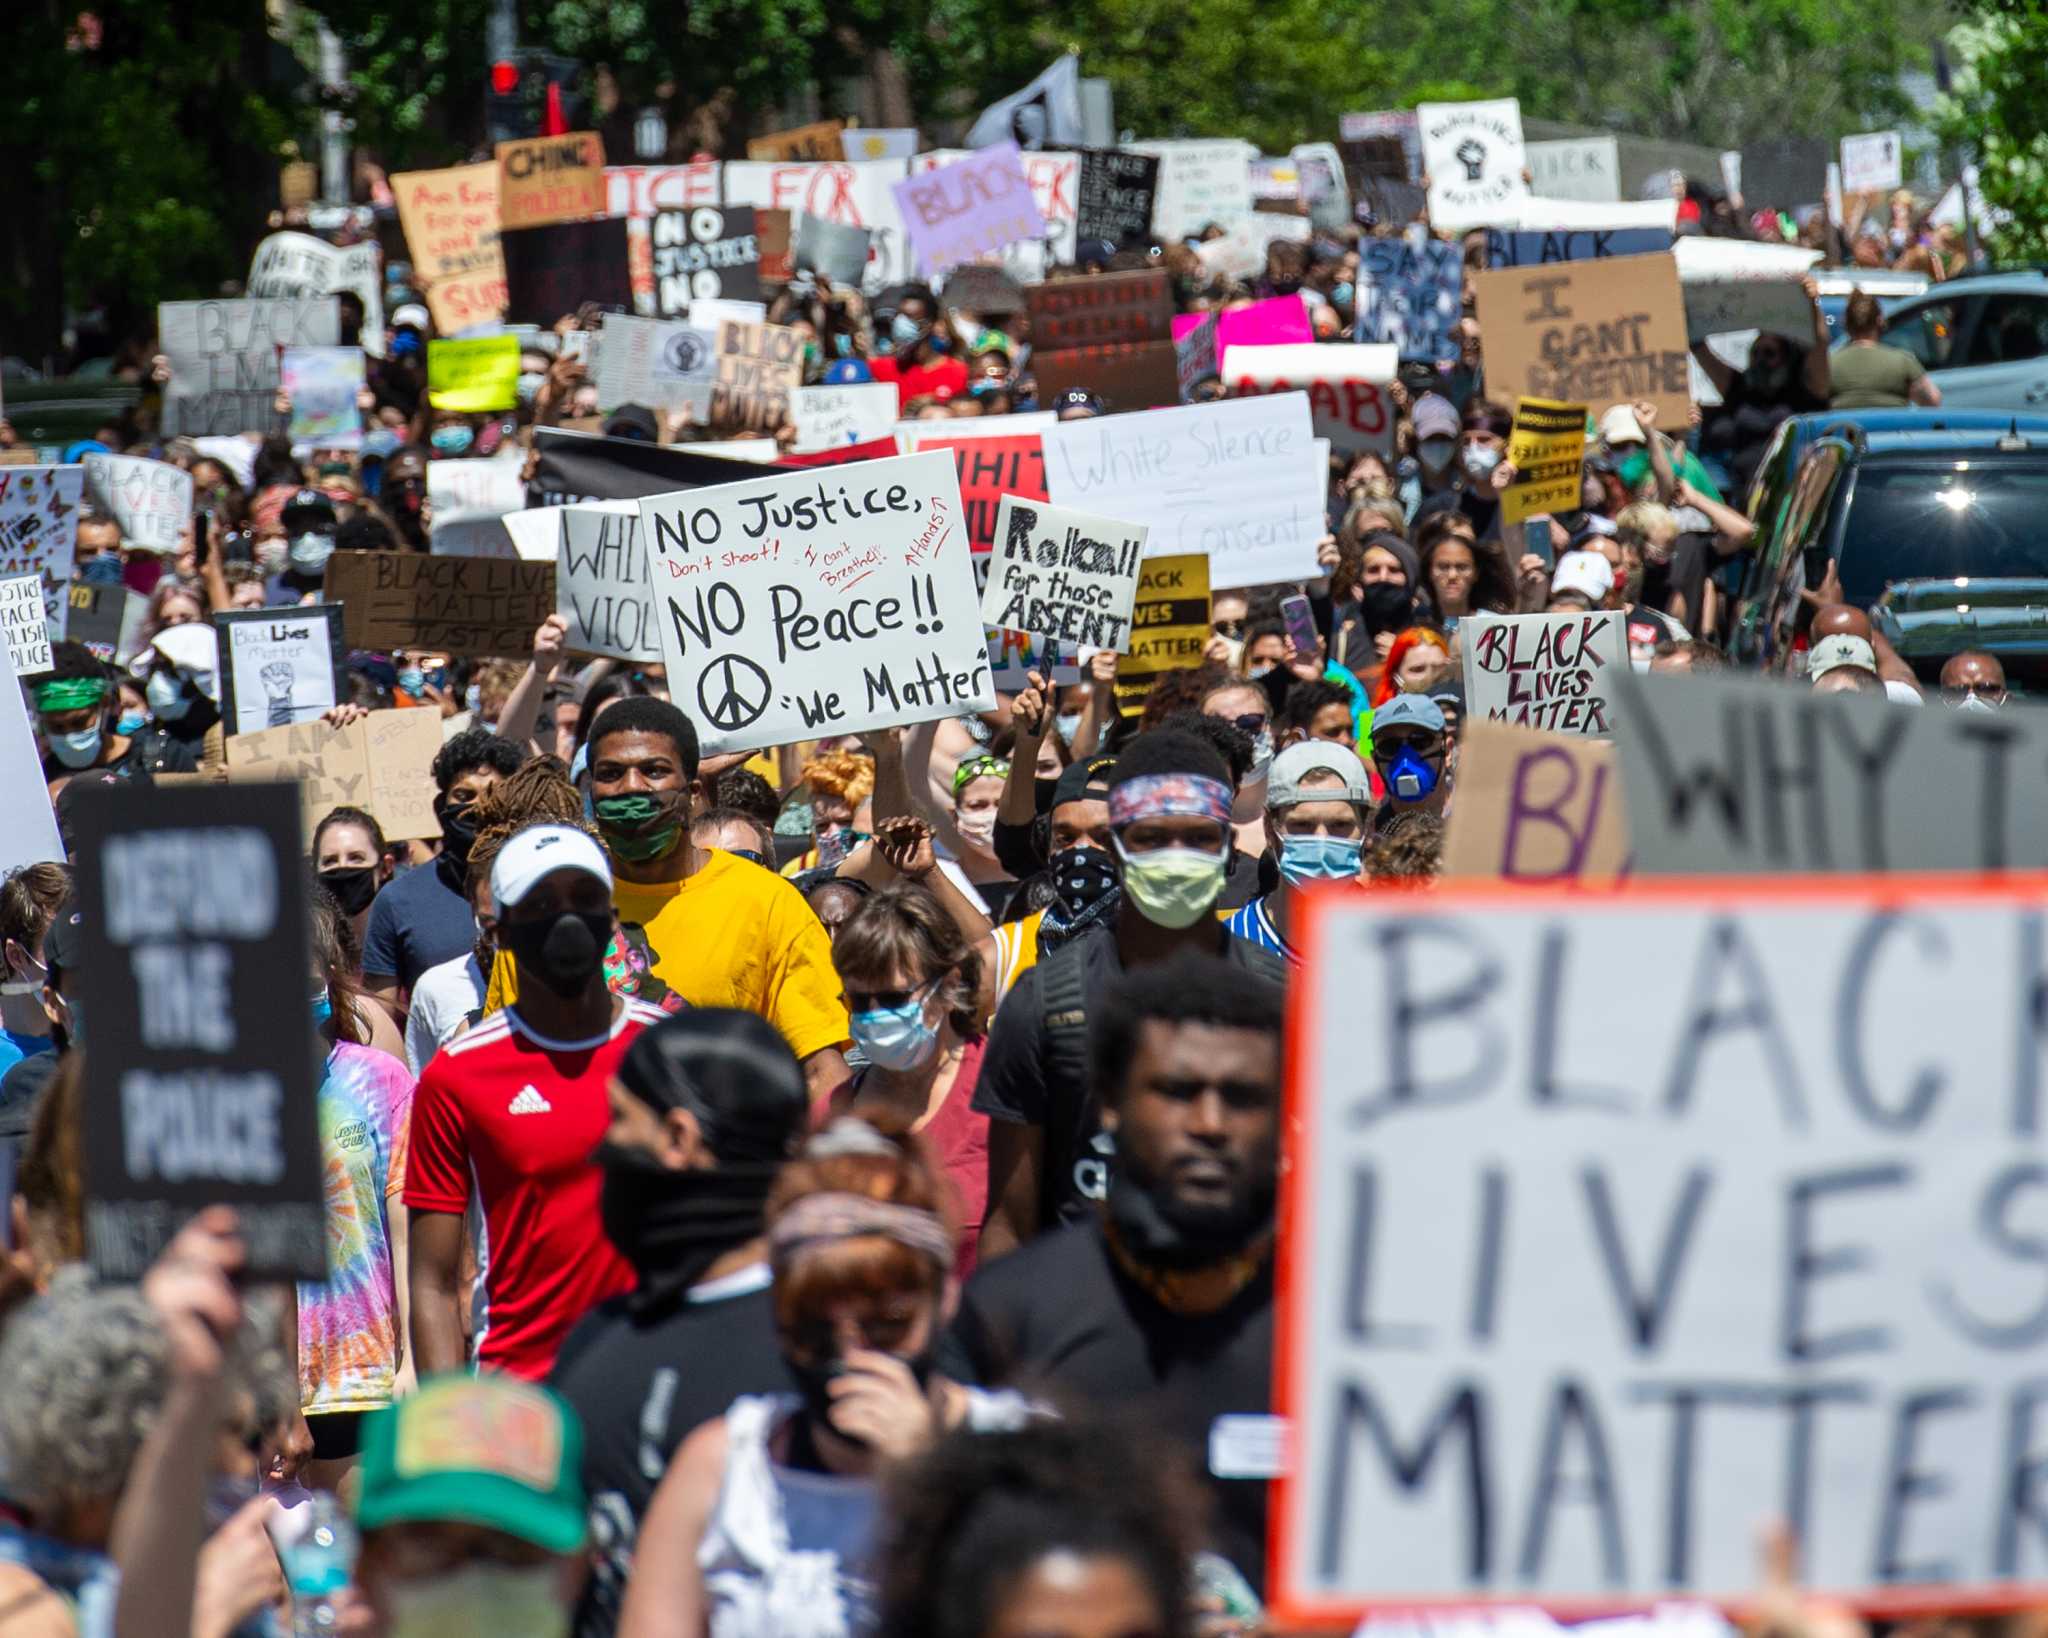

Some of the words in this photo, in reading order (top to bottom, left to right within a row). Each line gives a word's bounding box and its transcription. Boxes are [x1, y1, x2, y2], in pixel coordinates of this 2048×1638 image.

[654, 207, 724, 248] NO
[660, 268, 722, 315] NO
[1523, 275, 1572, 324] I
[1059, 435, 1173, 493] White
[1188, 417, 1294, 471] Silence
[654, 507, 722, 554] NO
[738, 483, 923, 538] Justice,
[561, 508, 650, 584] WHI
[373, 554, 468, 591] BLACK
[1003, 563, 1041, 596] for
[1047, 571, 1114, 610] those
[1137, 570, 1183, 590] ACK
[271, 624, 309, 642] Lives
[571, 595, 660, 652] VIOL
[668, 581, 745, 656] NO
[768, 573, 944, 664] Peace!!
[996, 594, 1129, 649] ABSENT
[1134, 602, 1174, 627] VES
[1475, 616, 1612, 674] BLACK
[1506, 668, 1595, 707] LIVES
[237, 734, 271, 764] I
[1608, 662, 1916, 870] WHY
